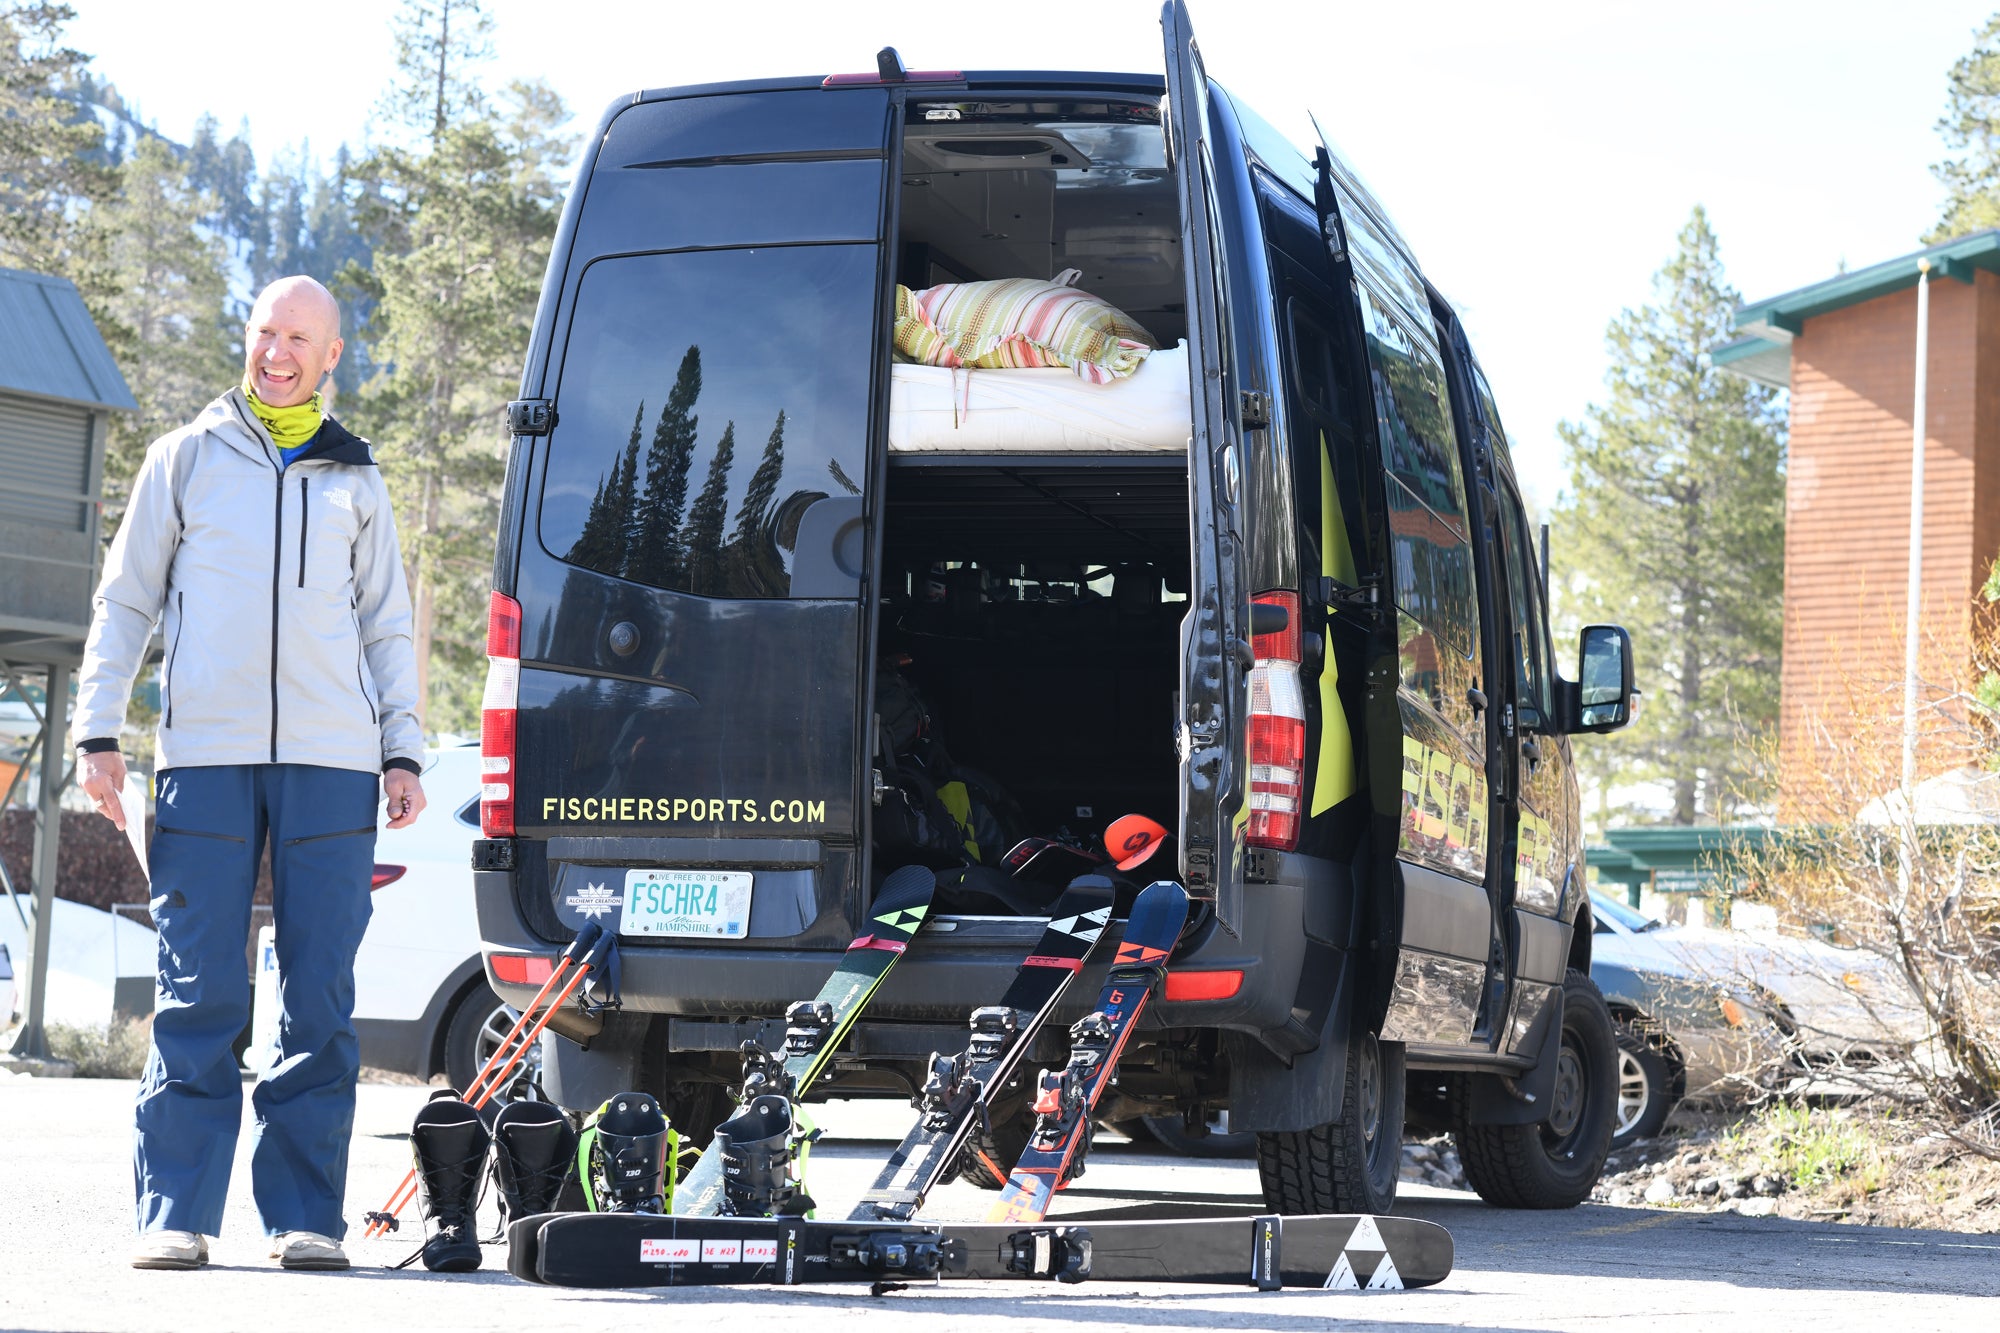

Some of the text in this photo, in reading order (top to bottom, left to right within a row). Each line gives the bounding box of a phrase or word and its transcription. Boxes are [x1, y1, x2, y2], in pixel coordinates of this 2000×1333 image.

[543, 797, 826, 823] FISCHERSPORTS.COM
[655, 873, 670, 881] LIVE
[630, 883, 718, 916] FSCHR4
[656, 922, 712, 933] HAMPSHIRE
[1109, 989, 1125, 1004] GT
[625, 1169, 641, 1177] 130
[727, 1167, 741, 1175] 130
